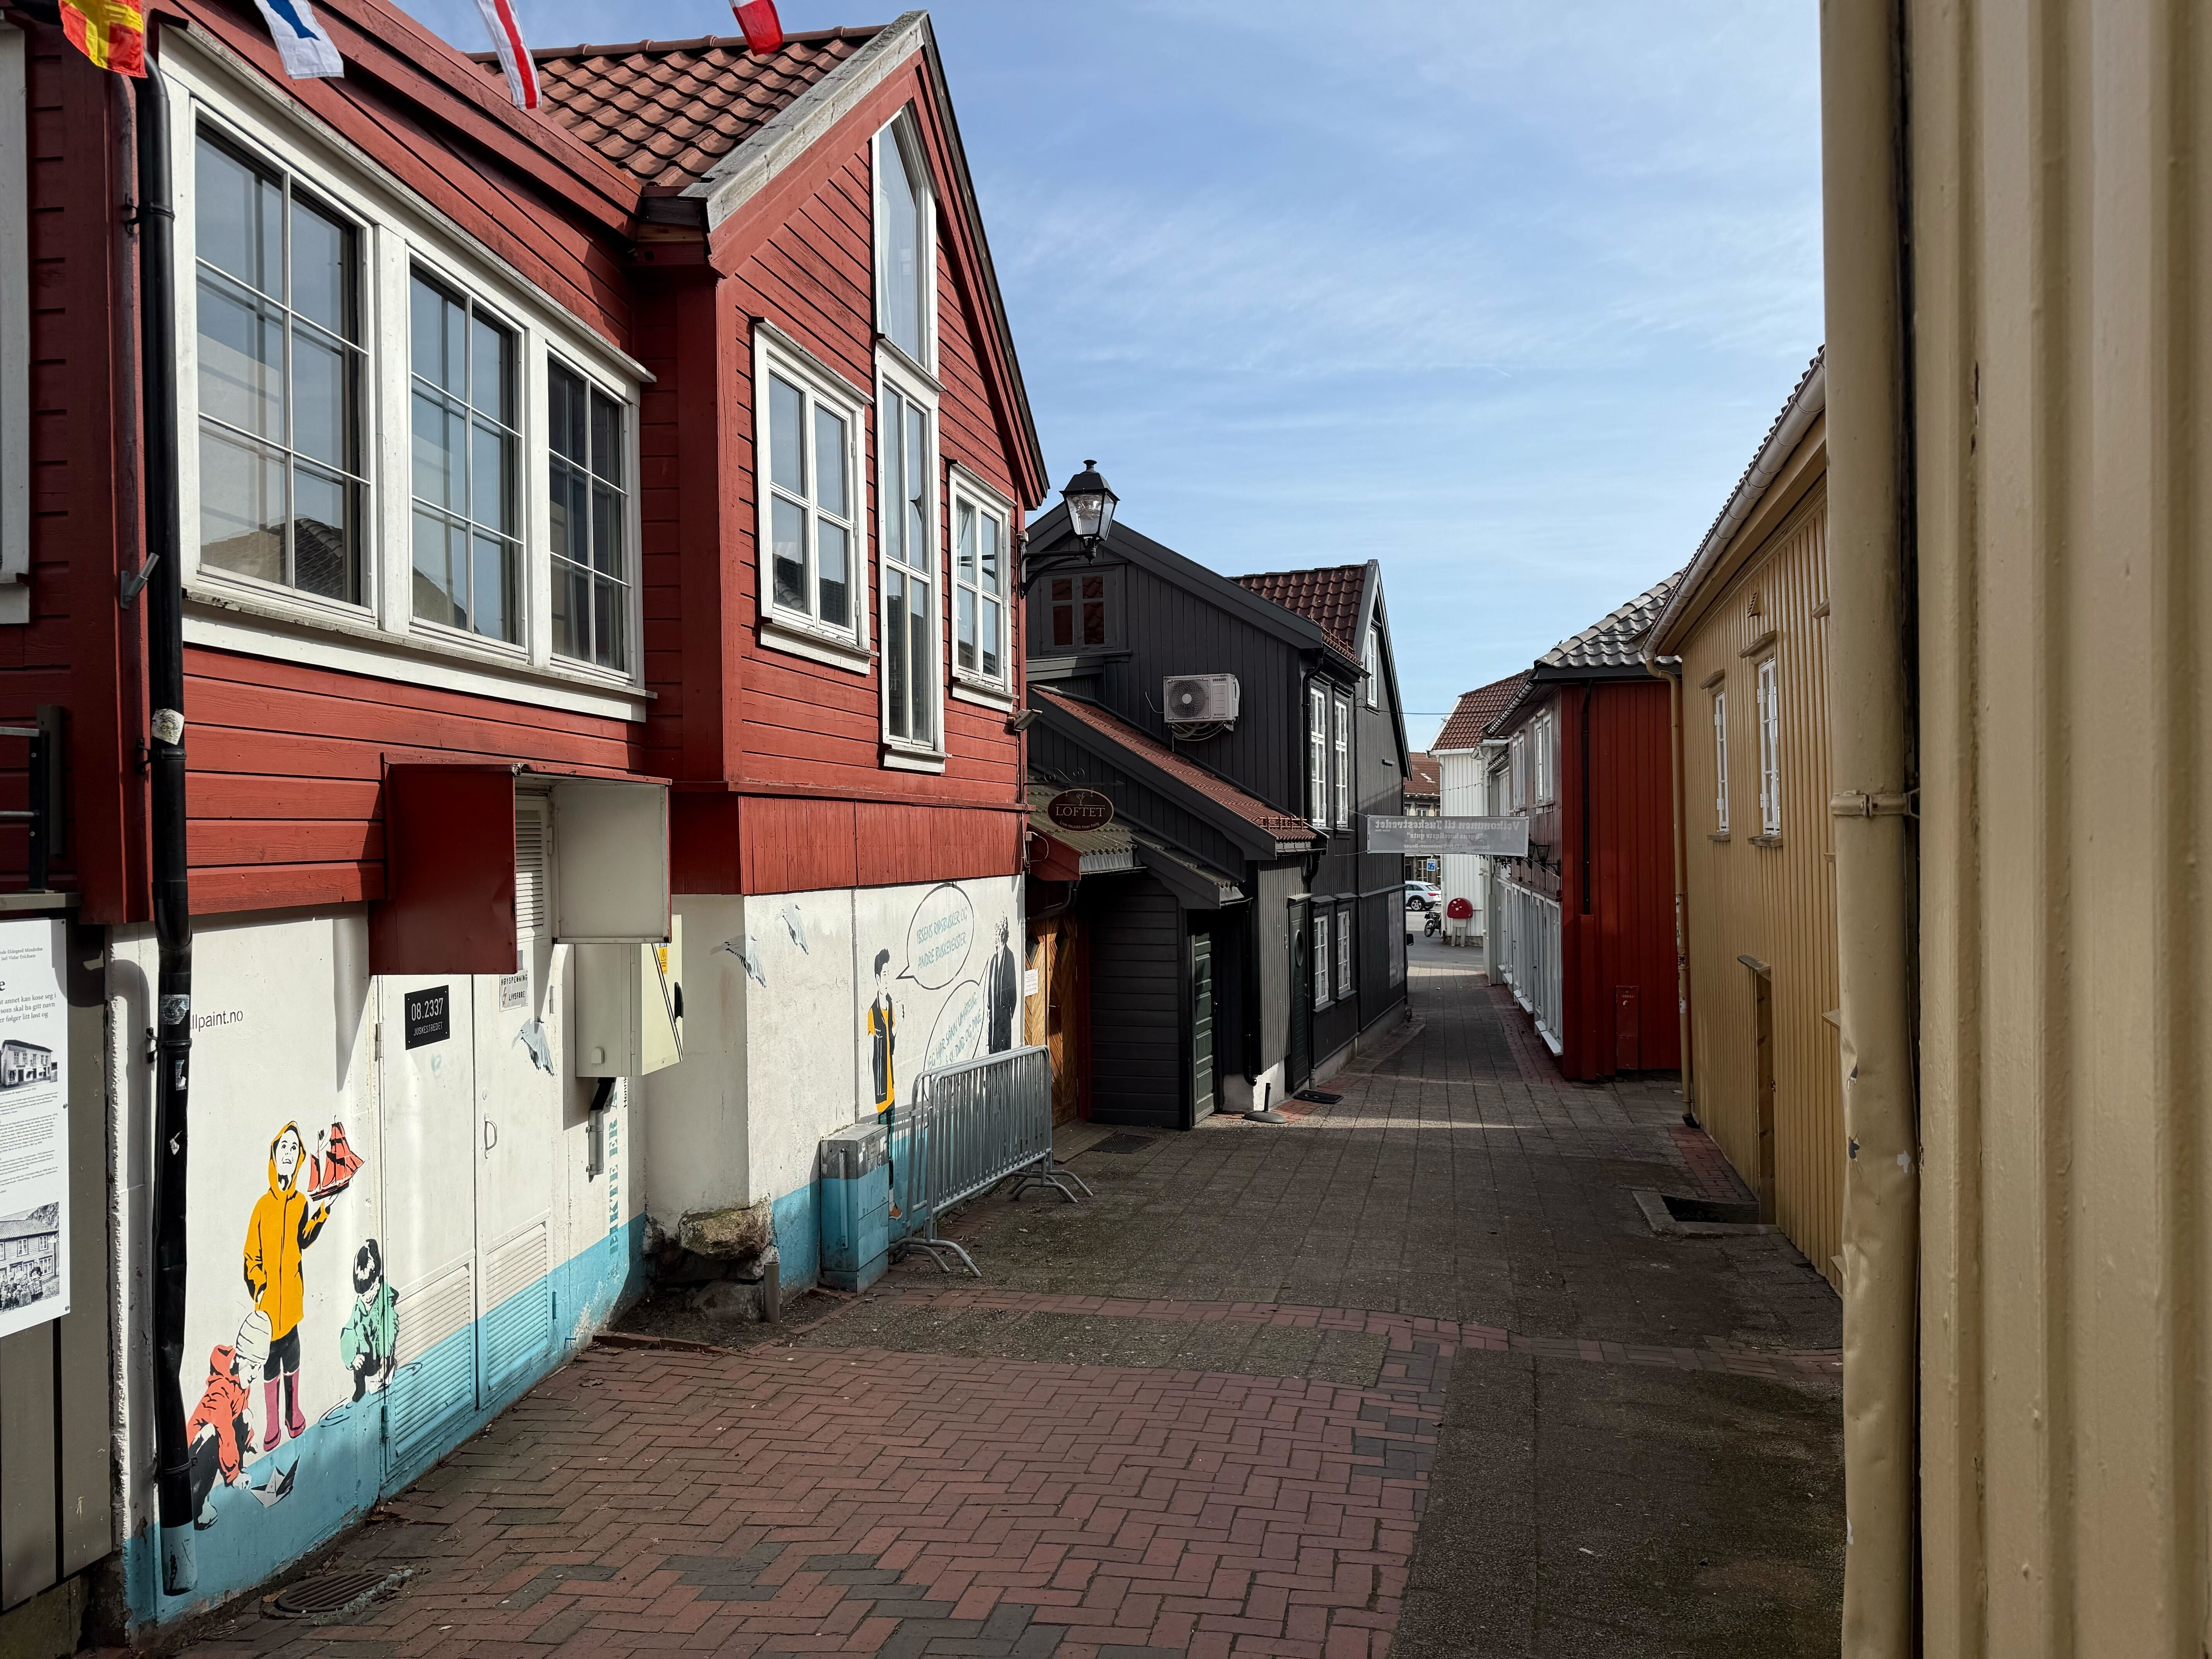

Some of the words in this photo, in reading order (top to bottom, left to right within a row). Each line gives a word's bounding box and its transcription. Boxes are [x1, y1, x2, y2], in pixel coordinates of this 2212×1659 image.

[1056, 807, 1105, 817] LOFTET
[917, 923, 933, 944] IBSENS
[934, 911, 960, 935] RIPSBUSKER
[961, 907, 967, 921] OG
[918, 949, 934, 971] ANDRE
[501, 974, 527, 986] HØYSPENNING
[509, 991, 525, 1001] LIVSFARE
[412, 998, 443, 1021] 08.2337
[190, 1011, 243, 1032] llpaint.no
[413, 1022, 443, 1036] JUSKESTREDET
[955, 1036, 965, 1057] DØD
[965, 1025, 972, 1042] OG
[972, 1008, 982, 1033] PINE
[609, 1117, 618, 1159] ER
[610, 1164, 618, 1255] DIKTE
